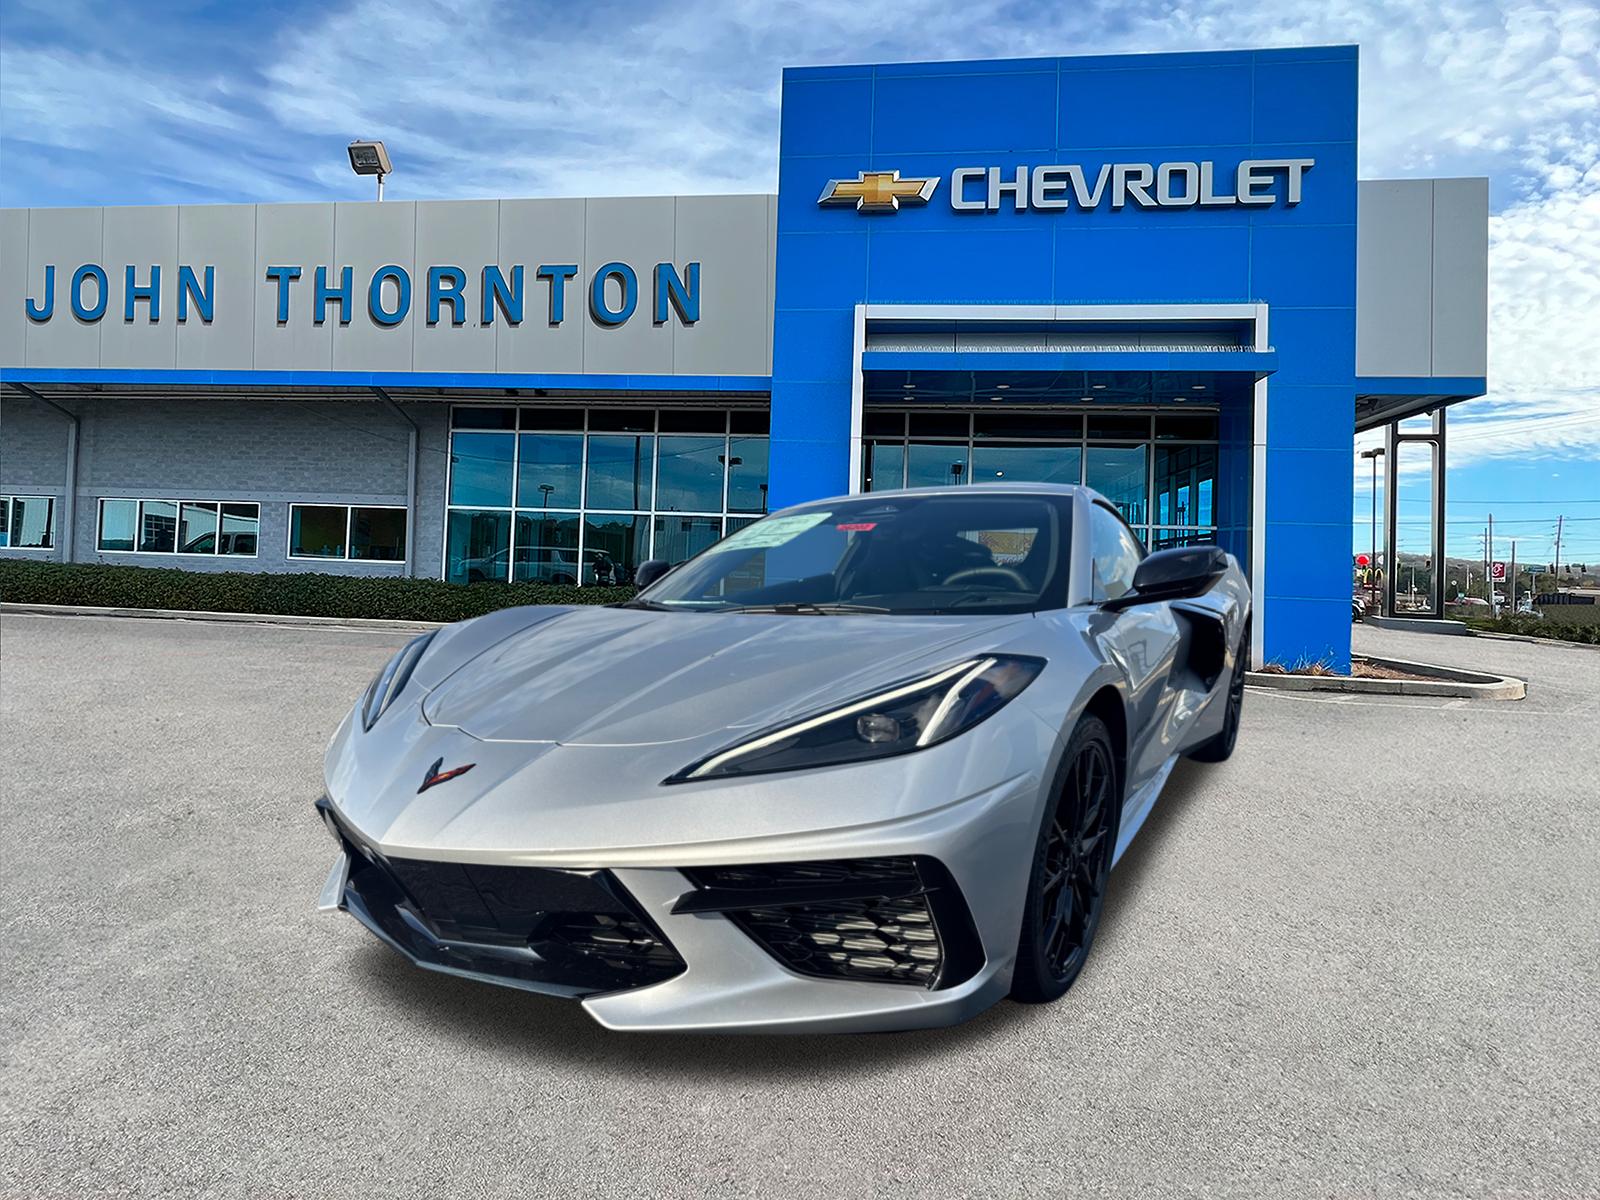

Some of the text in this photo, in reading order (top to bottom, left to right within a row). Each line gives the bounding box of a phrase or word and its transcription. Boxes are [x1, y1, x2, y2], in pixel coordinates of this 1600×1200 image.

[951, 158, 1315, 211] CHEVROLET
[26, 262, 701, 327] JOHN THORNTON
